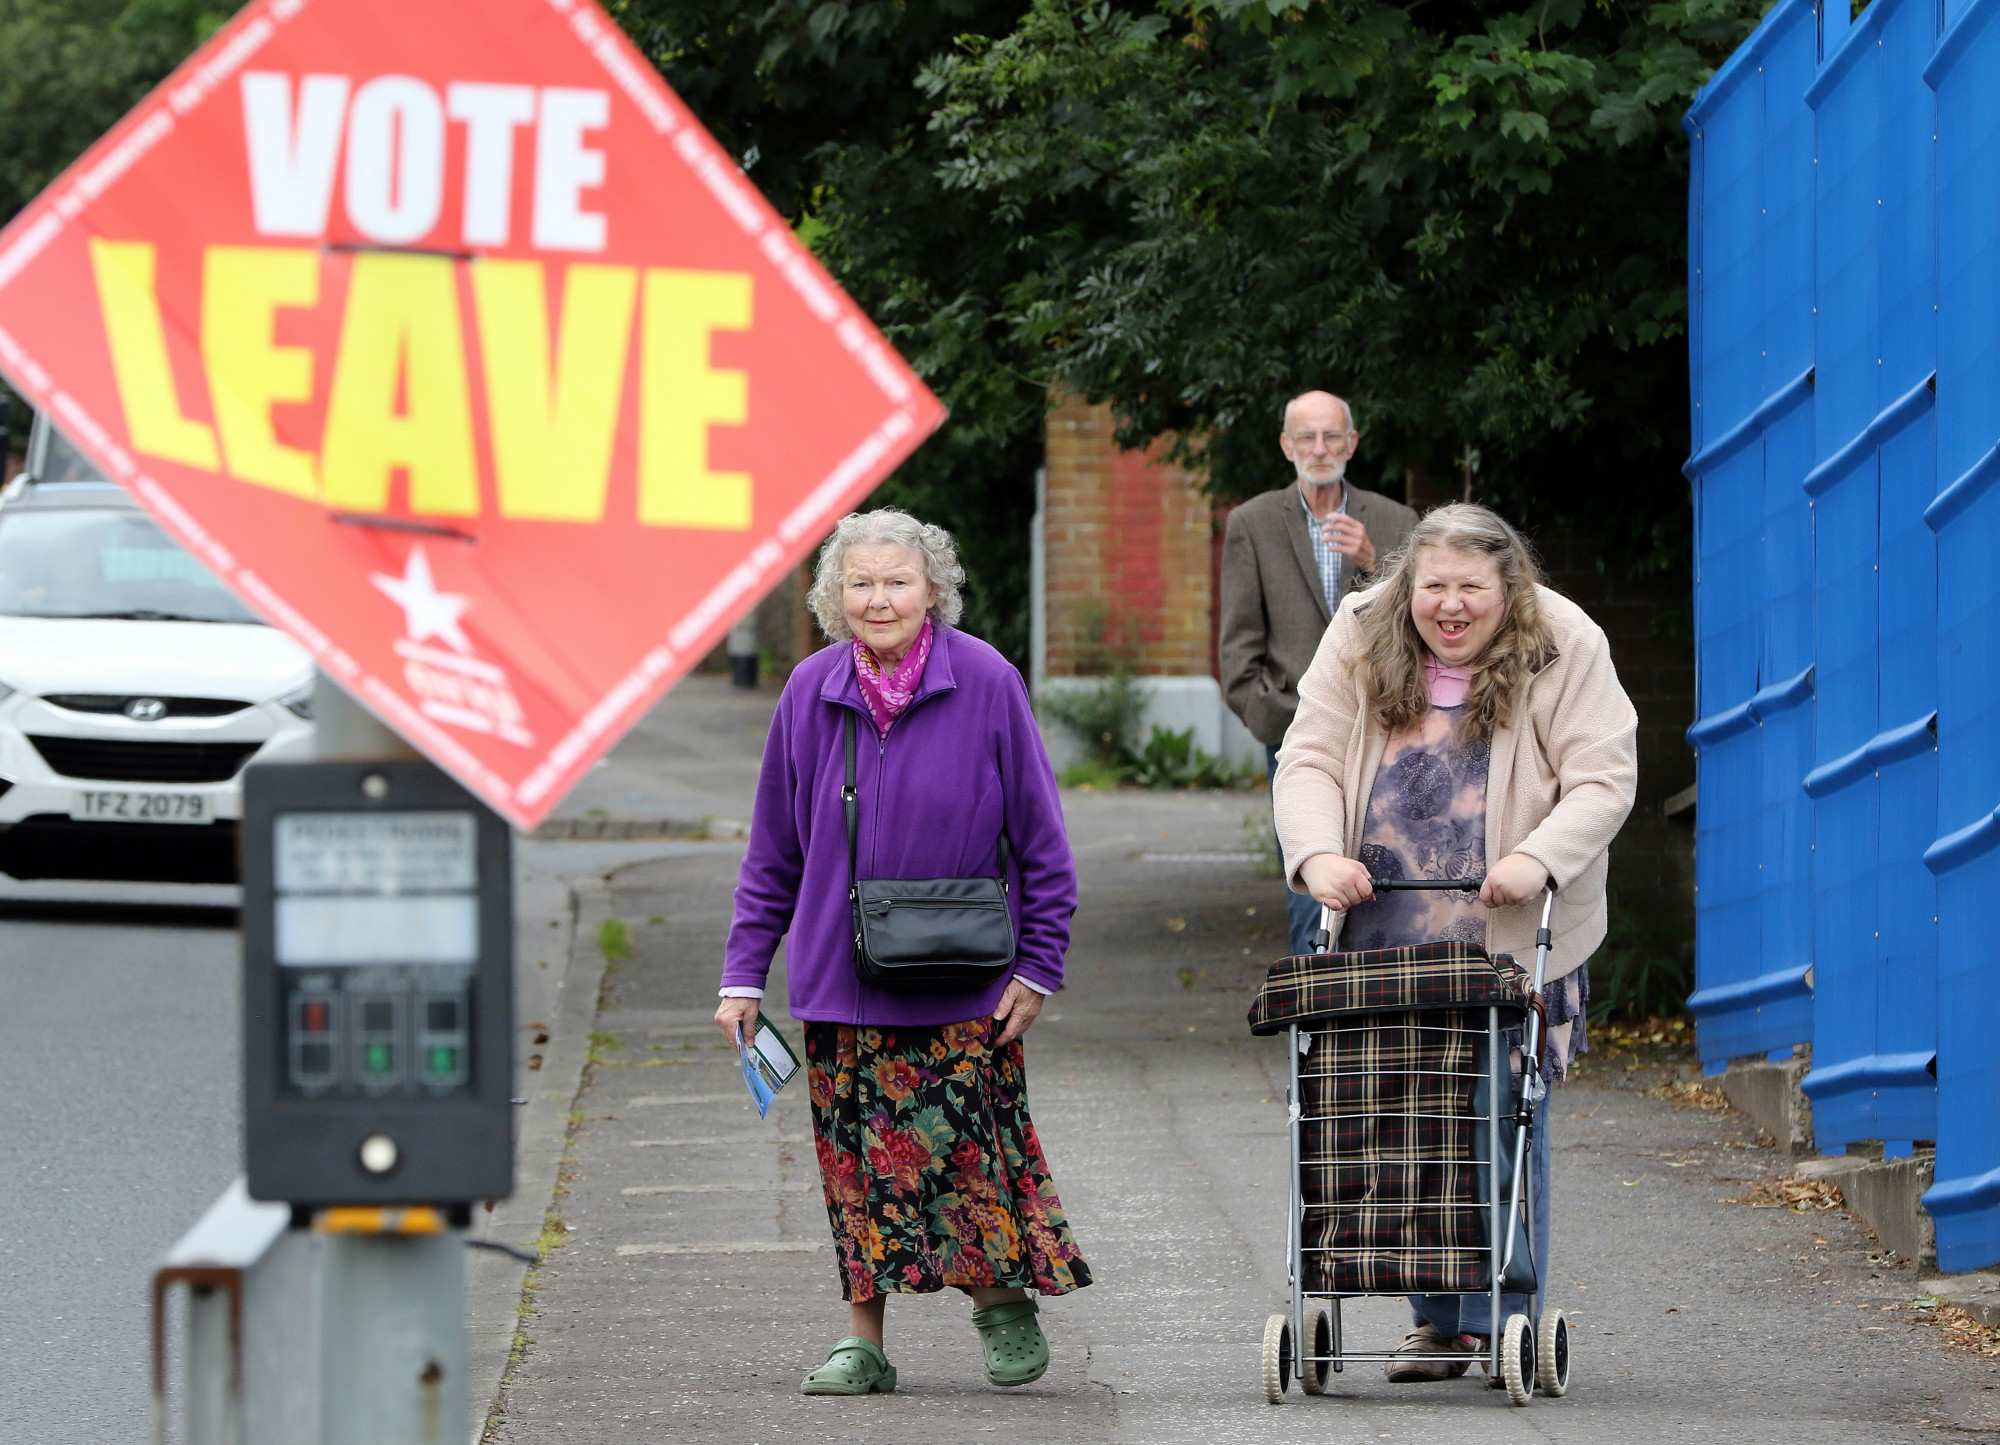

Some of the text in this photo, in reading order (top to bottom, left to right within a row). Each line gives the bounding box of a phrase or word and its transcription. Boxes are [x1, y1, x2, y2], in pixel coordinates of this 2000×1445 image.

[240, 70, 611, 252] VOTE
[88, 237, 754, 531] LEAVE
[81, 791, 206, 818] TFZ 2079
